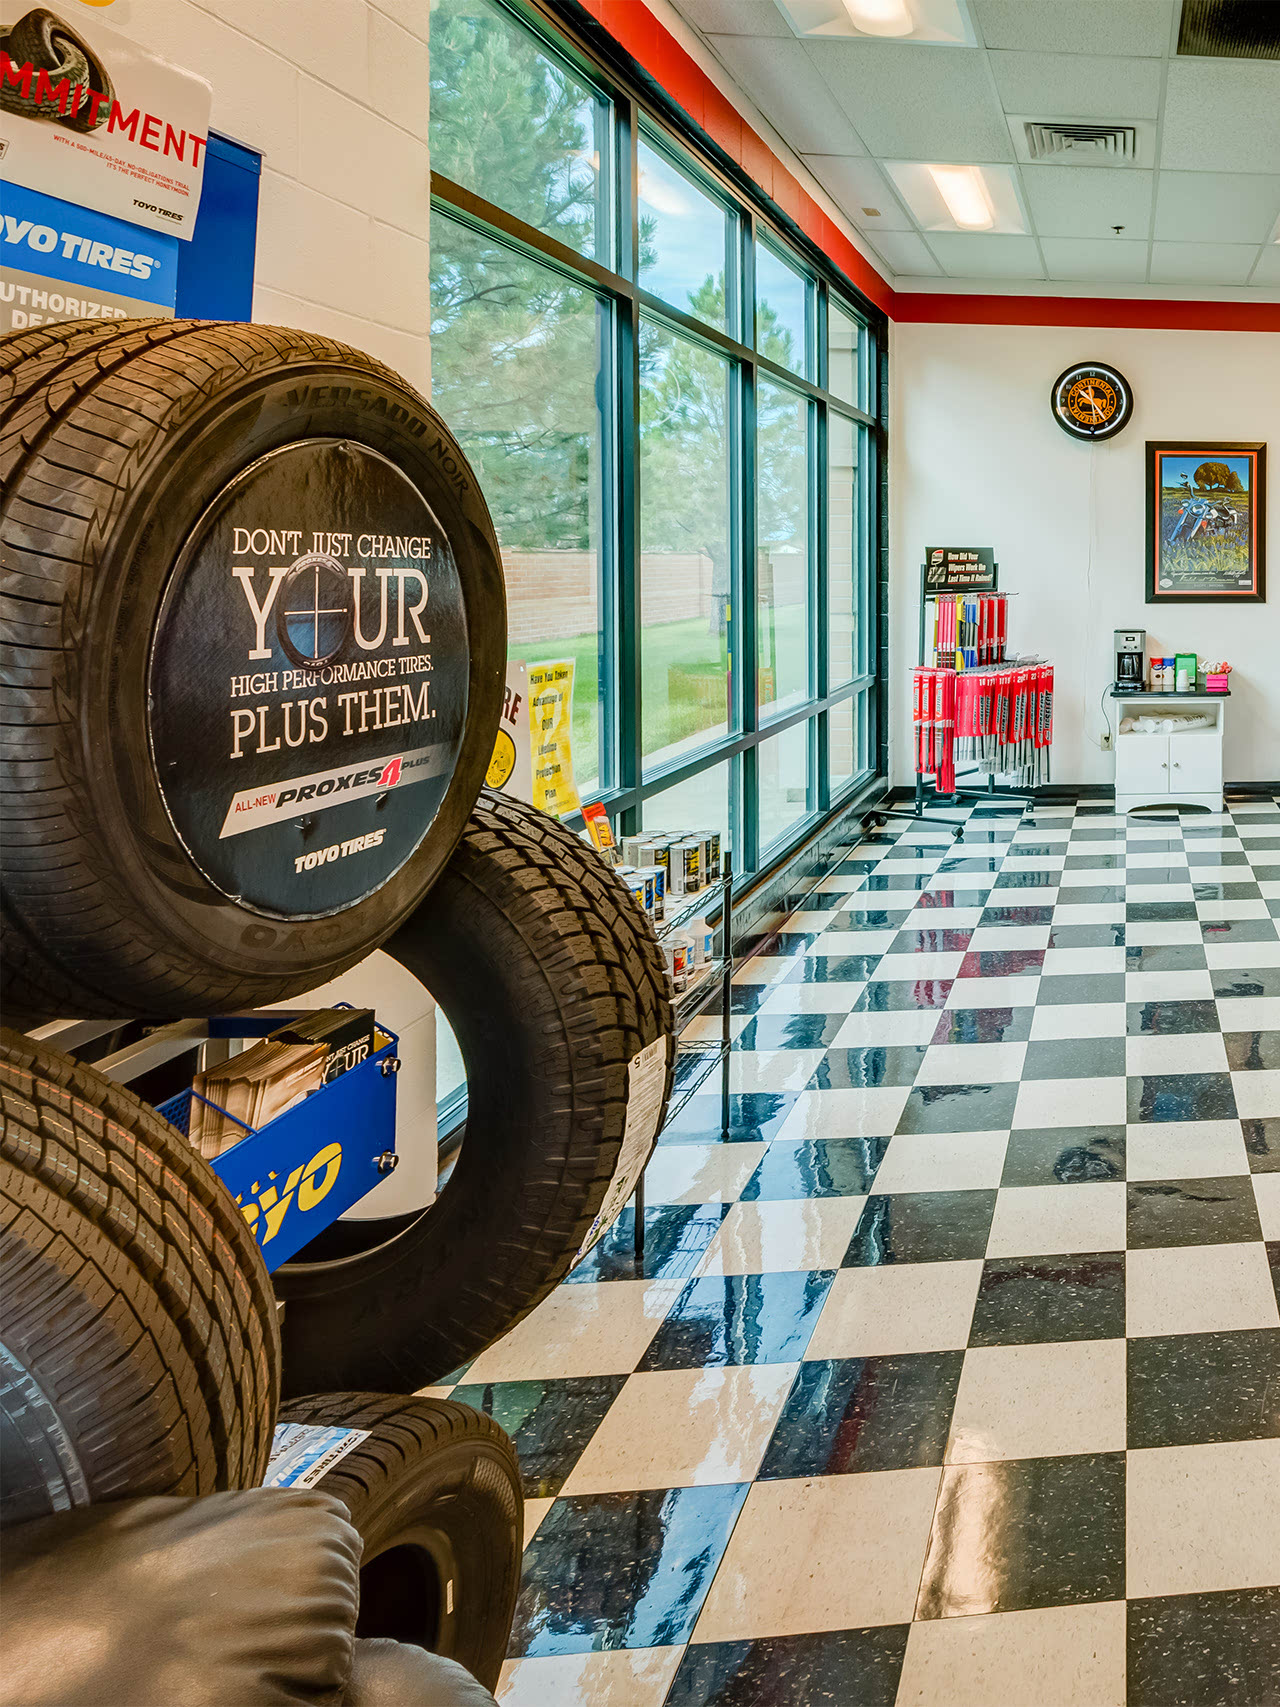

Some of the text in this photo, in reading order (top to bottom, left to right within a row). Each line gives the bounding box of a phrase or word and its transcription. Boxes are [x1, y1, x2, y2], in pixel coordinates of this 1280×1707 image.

[53, 134, 70, 145] WITH
[118, 166, 129, 175] THE
[130, 169, 155, 184] PERFECT
[133, 199, 184, 221] TOYO TIRES
[0, 213, 153, 280] YO TIRES
[1070, 379, 1114, 397] CONTINENTAL
[429, 437, 469, 500] NOIR
[307, 531, 352, 557] JUST
[357, 534, 431, 559] CHANGE
[230, 671, 279, 698] HIGH
[282, 658, 396, 691] PERFORMANCE
[530, 673, 543, 685] Have
[544, 671, 554, 682] You
[230, 696, 329, 759] PLUS
[535, 763, 561, 780] Protection
[234, 793, 277, 814] ALL-NEW
[400, 755, 431, 771] PLUS
[544, 788, 557, 800] Plan
[294, 829, 385, 874] TOYO TIRES
